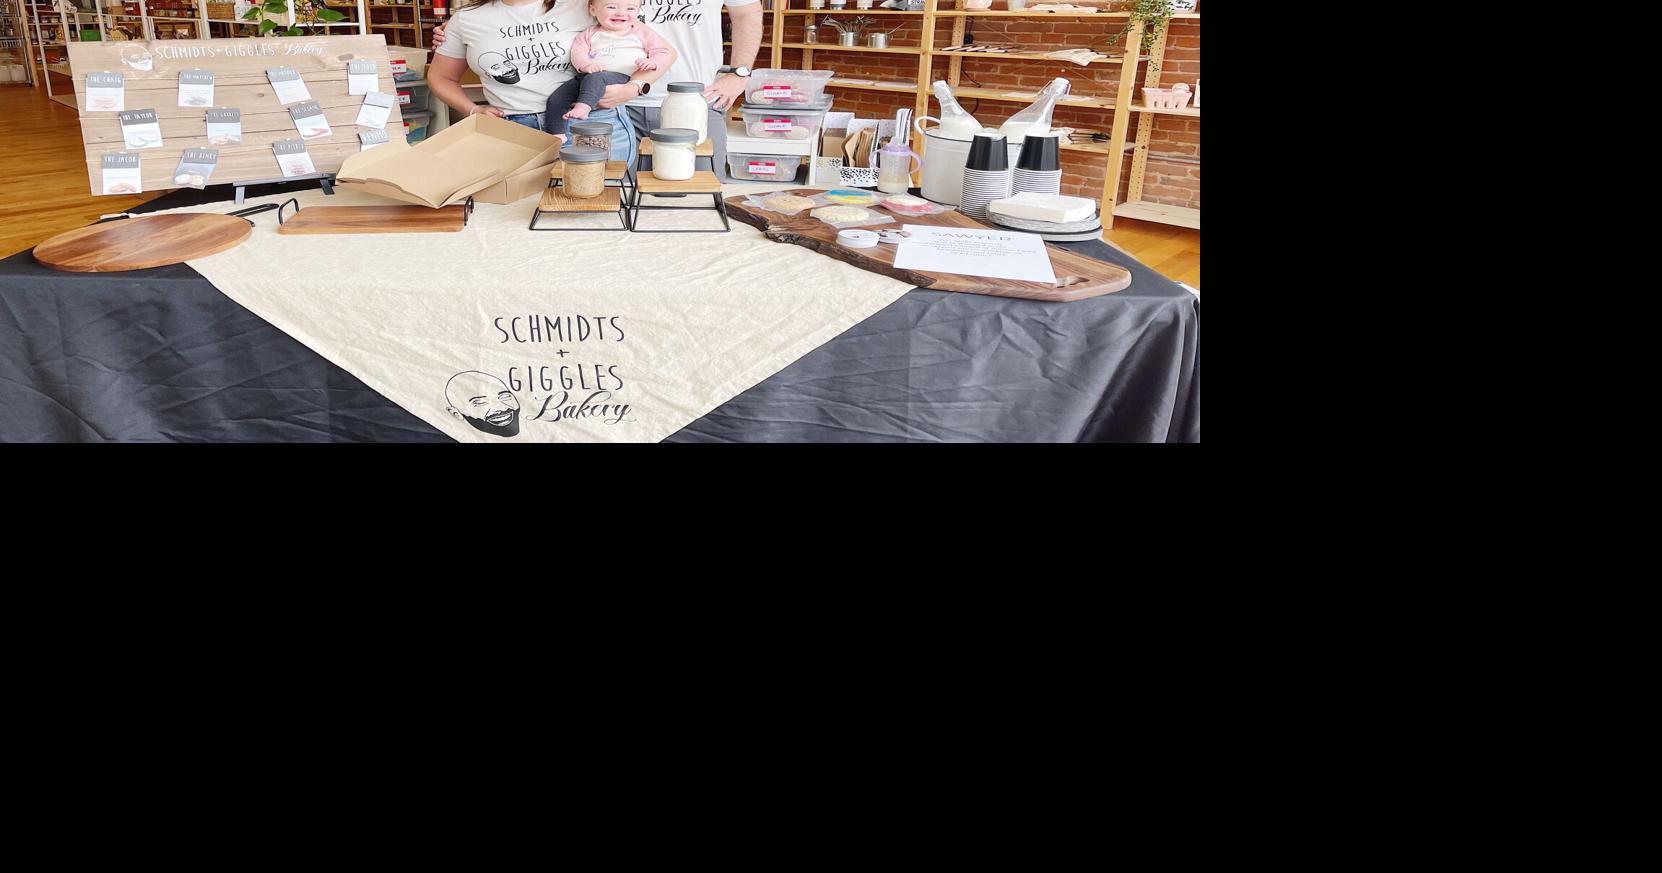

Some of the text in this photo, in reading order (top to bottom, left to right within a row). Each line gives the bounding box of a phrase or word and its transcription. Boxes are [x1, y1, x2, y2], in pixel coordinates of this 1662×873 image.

[651, 5, 702, 26] Bakery
[500, 21, 560, 38] SCHMIDTS
[155, 46, 215, 59] SCHMIDTS
[224, 43, 275, 57] GIGGLES
[284, 42, 324, 56] Bakery
[505, 41, 566, 61] GIGGLES
[521, 56, 572, 75] Bakery
[104, 155, 136, 163] THE JACOB
[494, 314, 626, 344] SCHMIDTS
[556, 348, 571, 358] +
[509, 363, 624, 393] GIGGLES
[526, 390, 638, 426] Bakery
